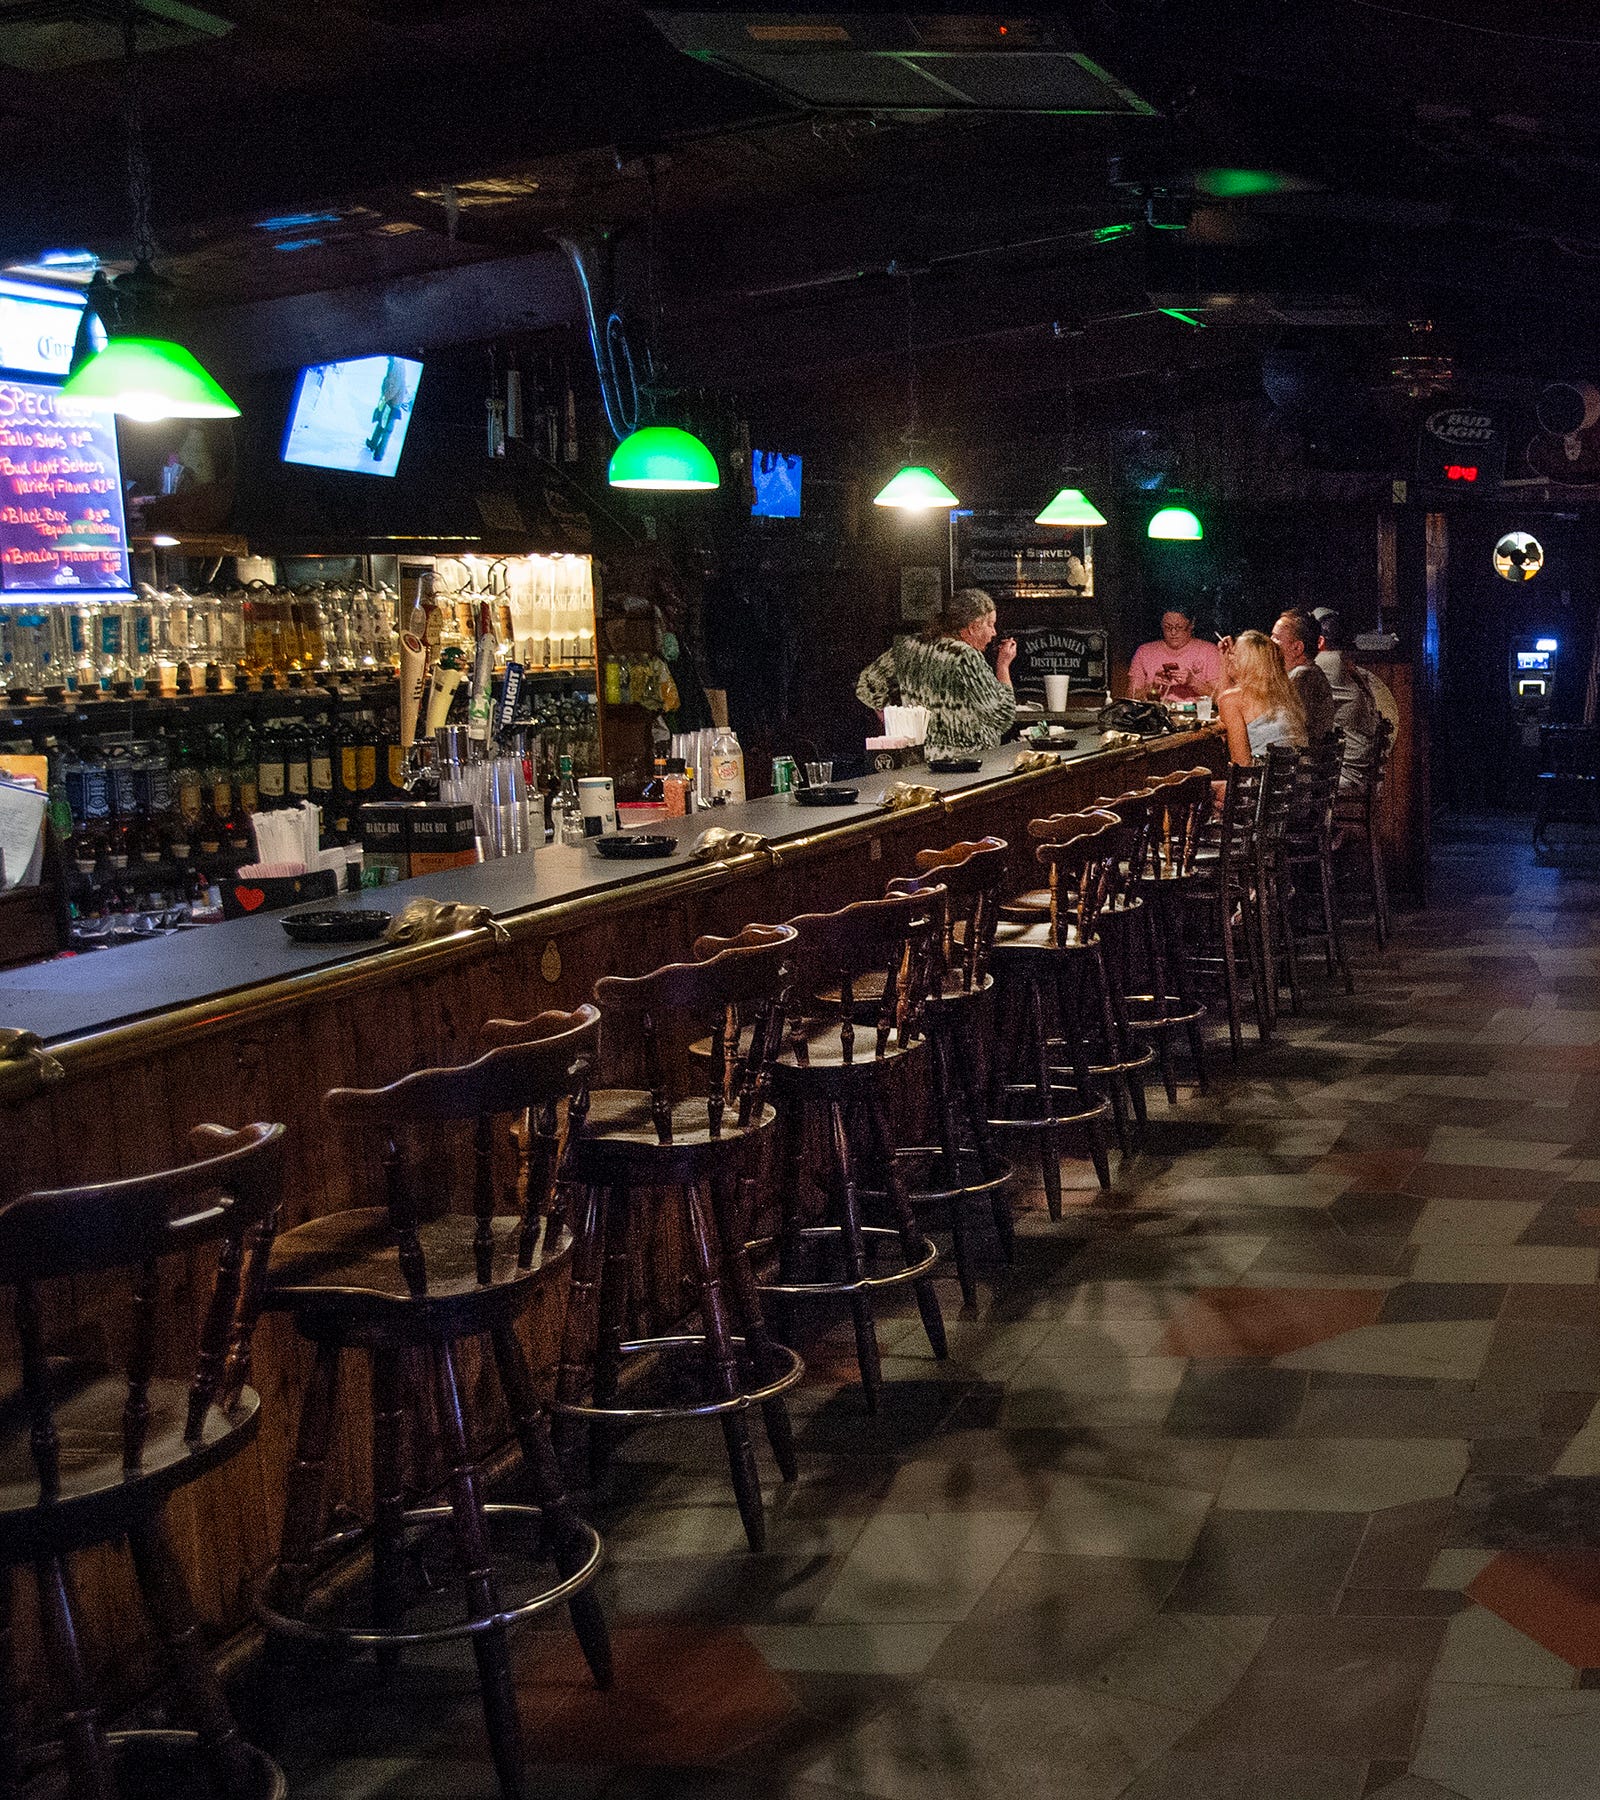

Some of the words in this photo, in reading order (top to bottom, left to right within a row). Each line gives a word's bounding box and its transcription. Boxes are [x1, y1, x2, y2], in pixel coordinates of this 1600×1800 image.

[1448, 414, 1491, 428] BUD
[0, 430, 33, 446] Jello
[1438, 426, 1495, 440] LIGHT
[3, 457, 30, 475] Bud
[32, 459, 60, 480] Light
[61, 457, 104, 474] Seltzers
[16, 479, 56, 499] Variety
[57, 479, 90, 494] Flavors
[8, 506, 44, 524] Black
[43, 507, 68, 521] Box
[36, 523, 73, 540] Tequila
[1027, 548, 1072, 558] SERVED
[1025, 637, 1048, 654] JACK
[1031, 656, 1081, 668] DISTILLERY
[507, 671, 520, 706] LIGHT
[366, 823, 386, 833] BLACK
[387, 823, 400, 833] BOX
[414, 822, 433, 833] BLACK
[435, 822, 448, 833] BOX
